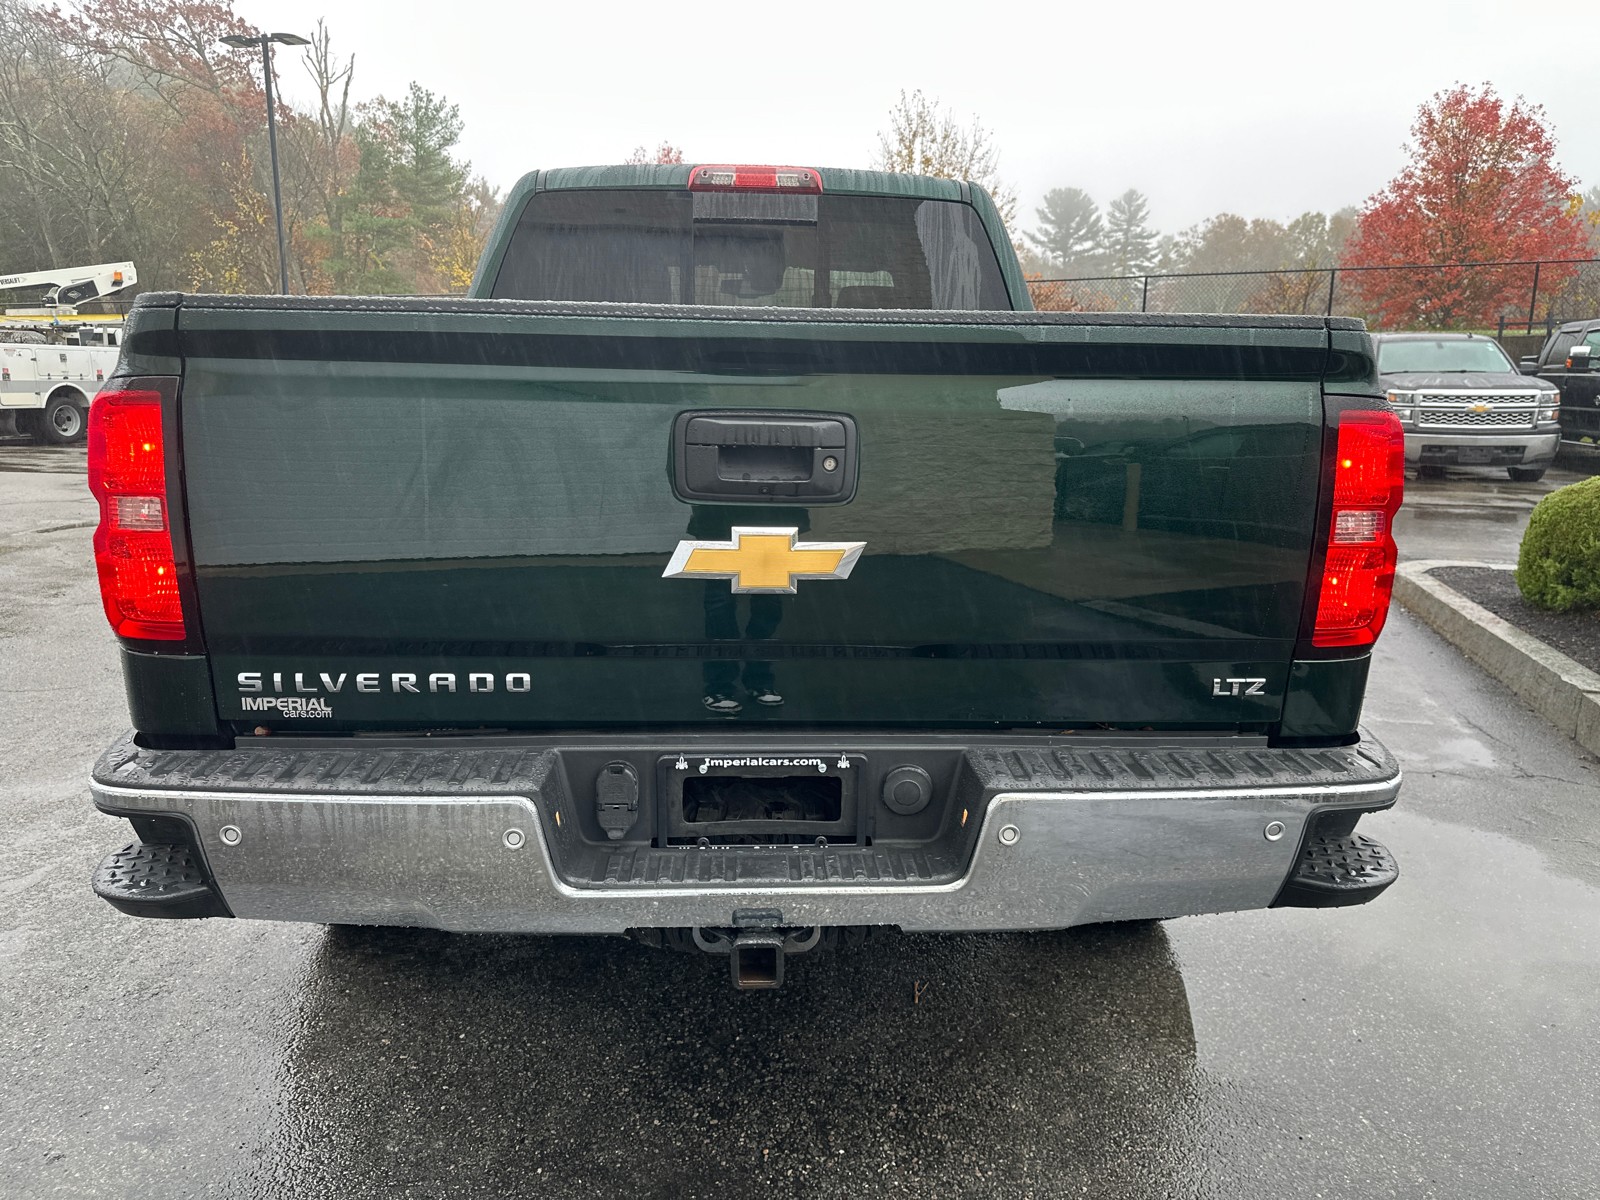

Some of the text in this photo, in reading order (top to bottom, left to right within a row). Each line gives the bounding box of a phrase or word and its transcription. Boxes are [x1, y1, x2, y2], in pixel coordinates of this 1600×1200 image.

[237, 672, 531, 693] SILVERADO
[1212, 678, 1267, 696] LTZ
[241, 697, 333, 711] IMPERIAL
[282, 710, 333, 718] cars.com
[704, 757, 822, 768] Imperialcars.com
